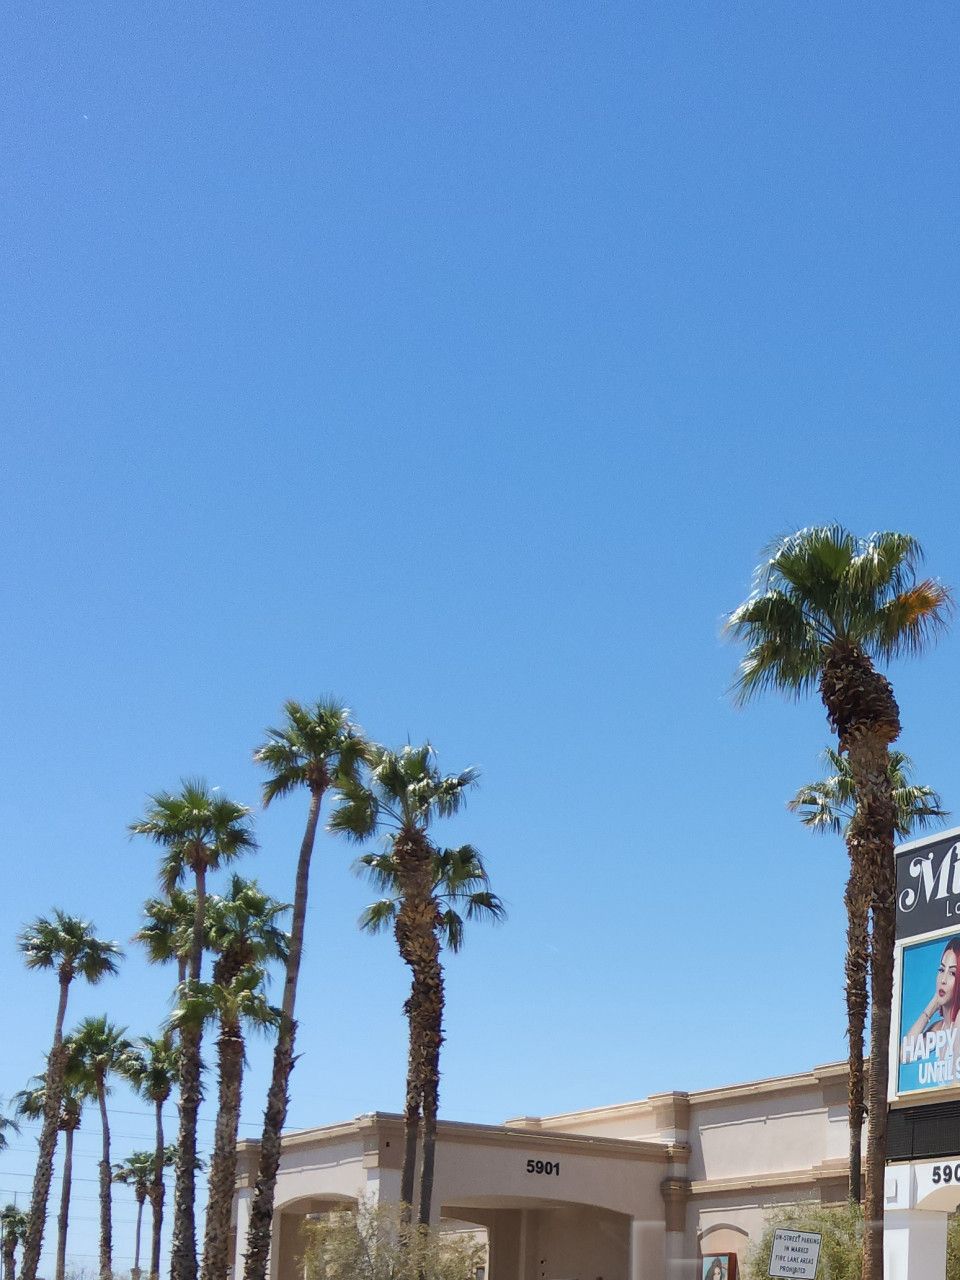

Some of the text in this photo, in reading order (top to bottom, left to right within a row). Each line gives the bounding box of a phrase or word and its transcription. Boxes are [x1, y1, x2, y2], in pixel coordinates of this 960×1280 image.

[902, 1028, 958, 1065] HAPPY
[918, 1058, 955, 1084] UNTIL
[526, 1159, 560, 1176] 5901
[787, 1255, 800, 1263] LANE
